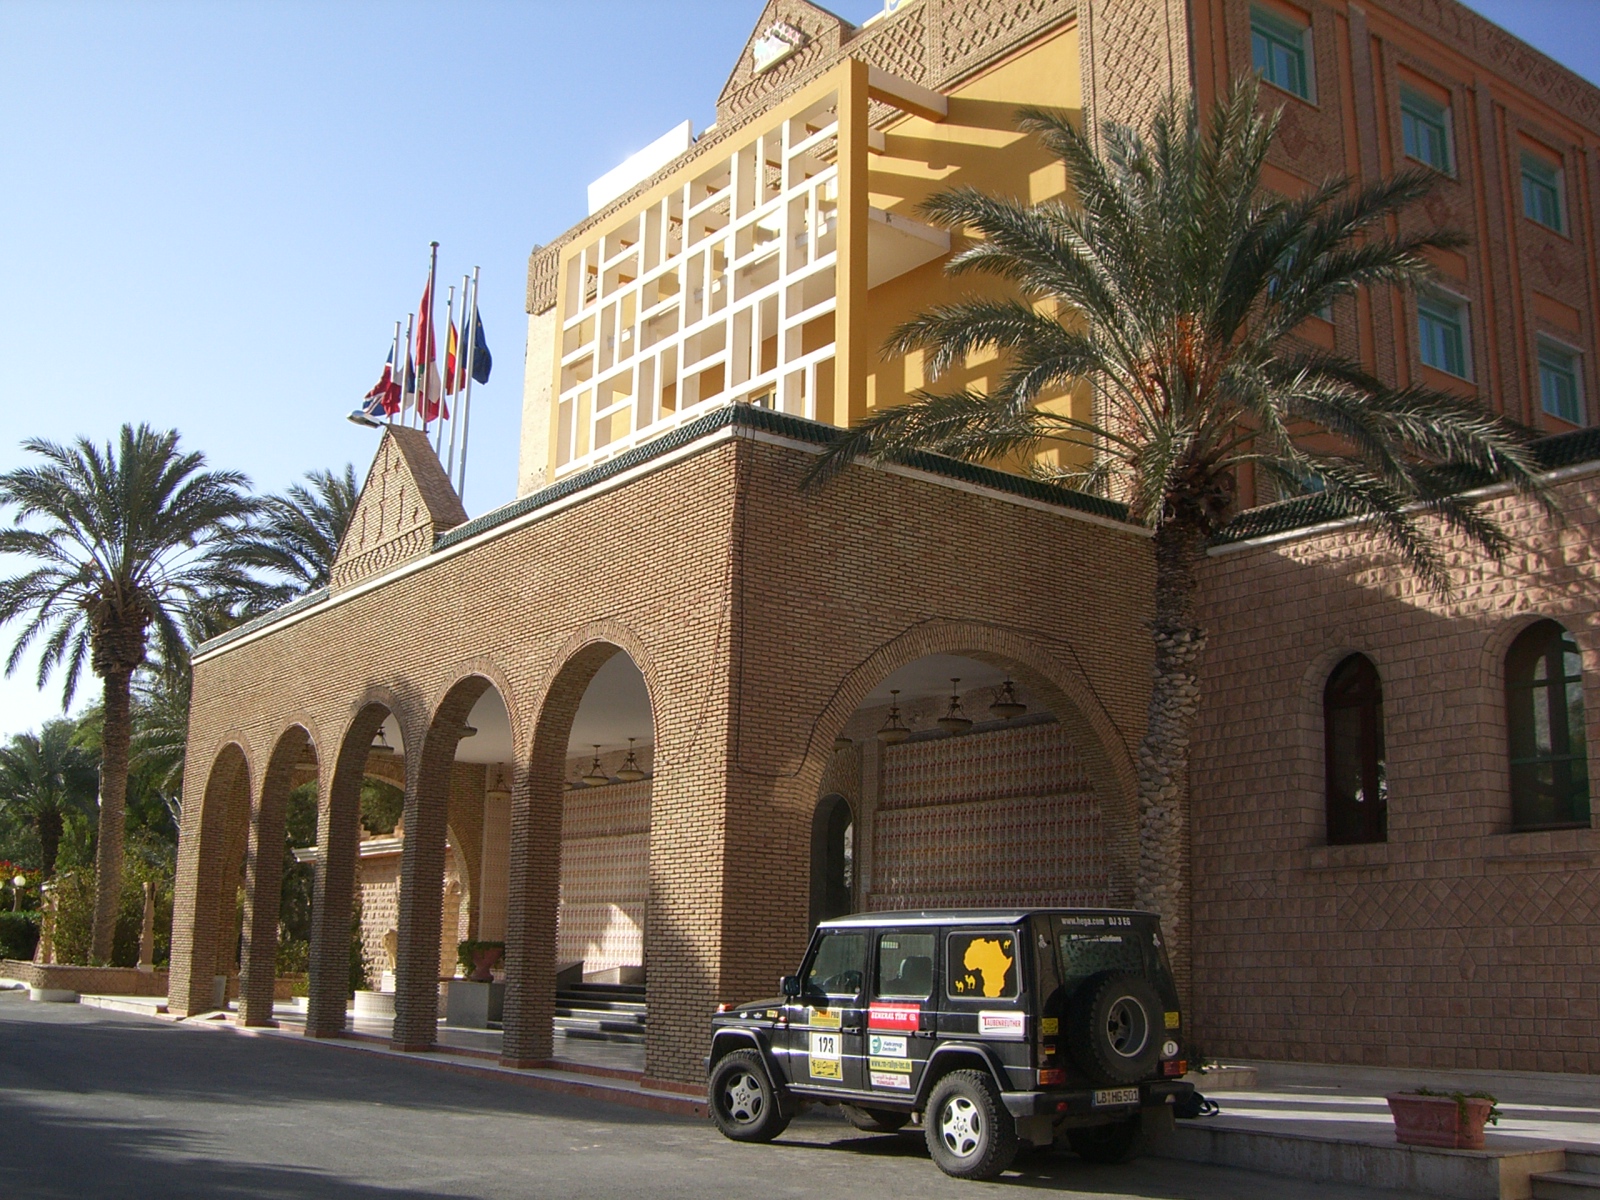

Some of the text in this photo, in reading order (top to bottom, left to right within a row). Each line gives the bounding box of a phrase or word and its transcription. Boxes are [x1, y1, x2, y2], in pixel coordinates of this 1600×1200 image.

[871, 1012, 895, 1020] GENERAL
[895, 1013, 907, 1021] TIRE
[1167, 1043, 1174, 1054] D
[1096, 1091, 1107, 1104] LB
[1123, 1090, 1138, 1101] 501
